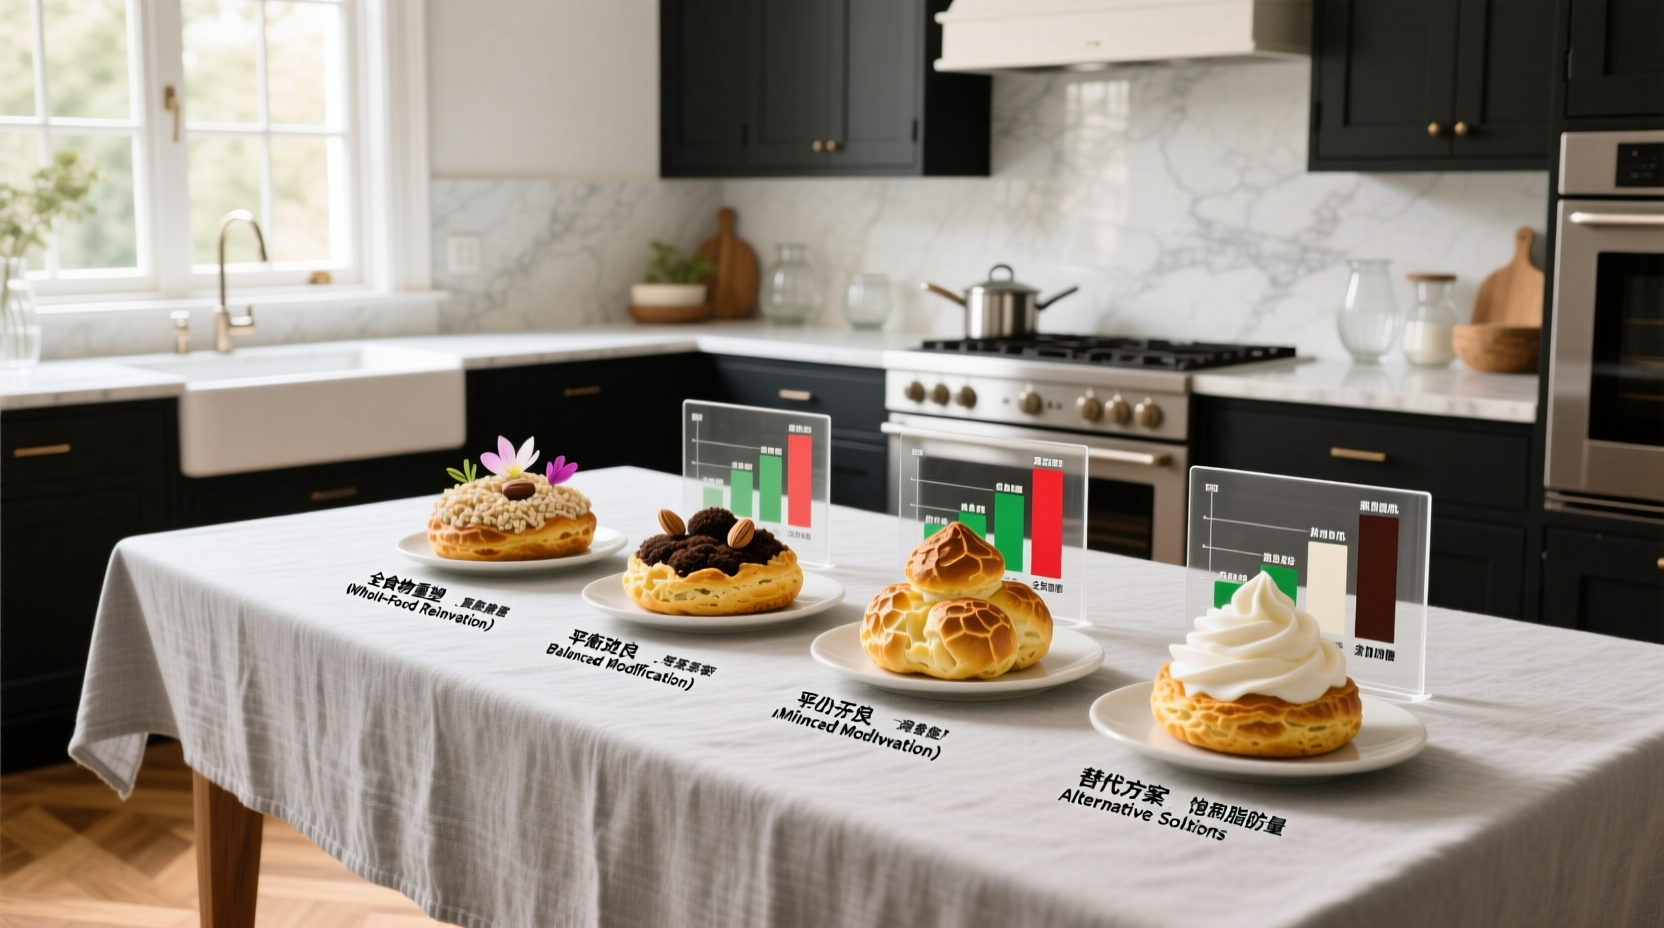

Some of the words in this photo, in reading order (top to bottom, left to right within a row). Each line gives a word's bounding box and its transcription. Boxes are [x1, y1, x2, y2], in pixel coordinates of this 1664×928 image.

[1058, 788, 1154, 822] Alternative
[1079, 767, 1170, 807] 替代方案
